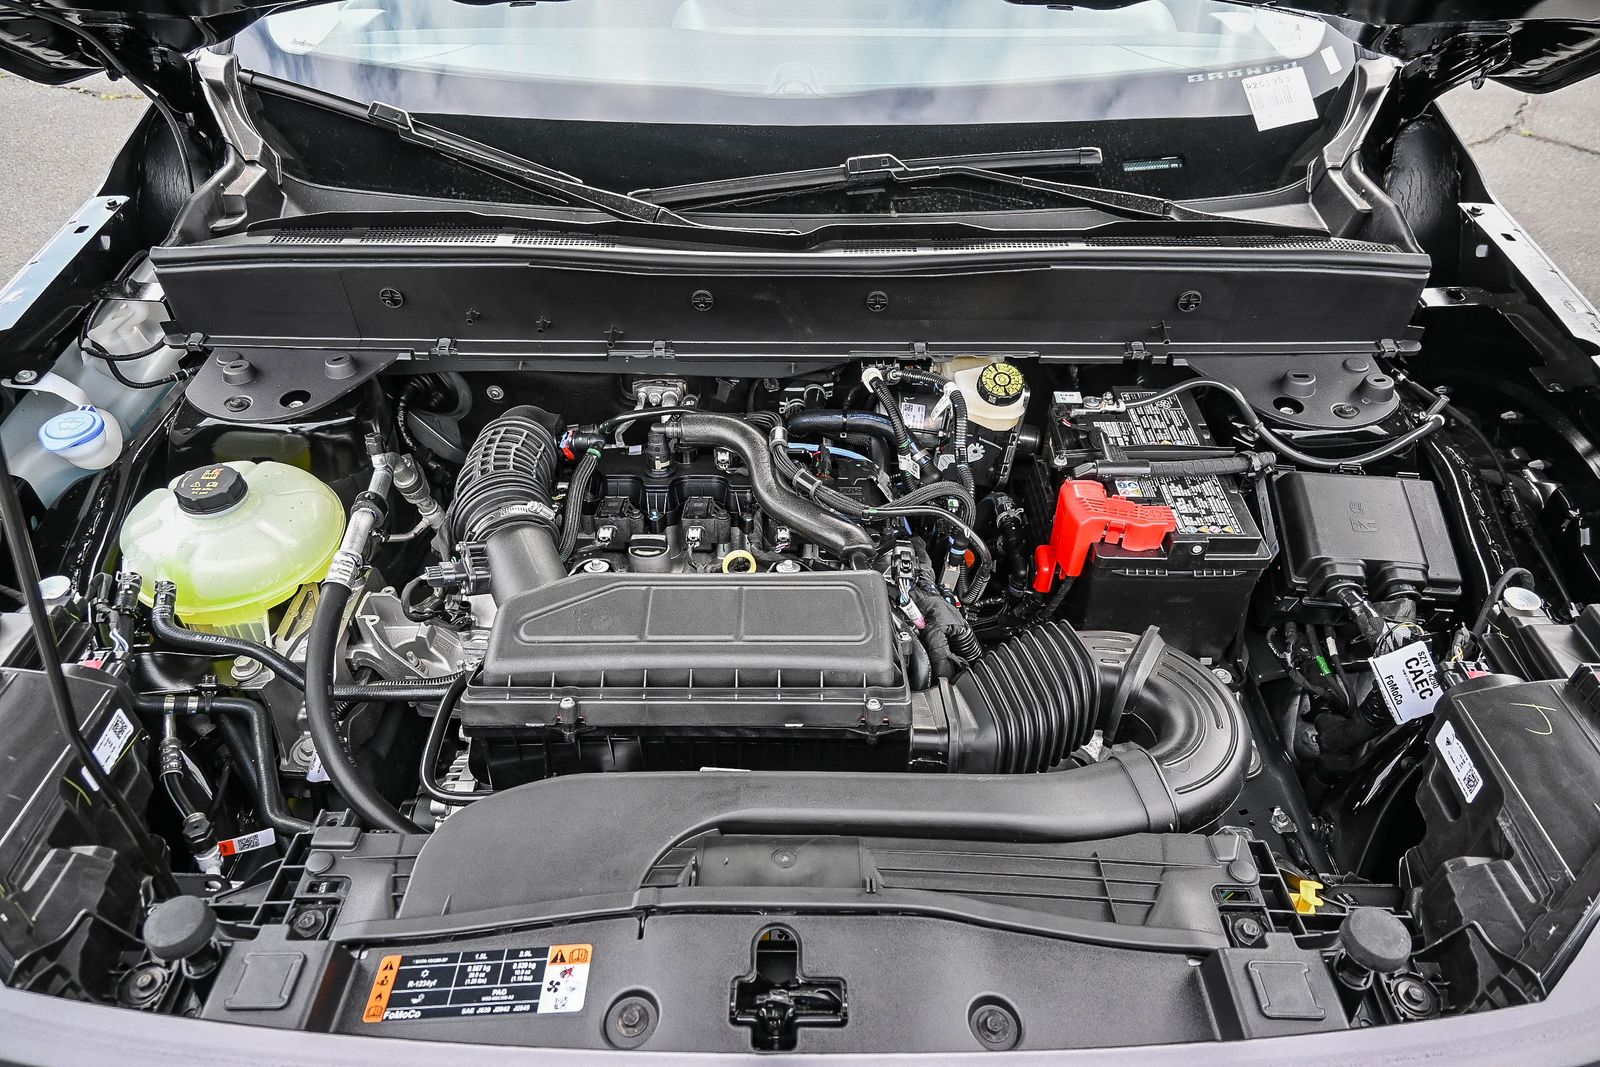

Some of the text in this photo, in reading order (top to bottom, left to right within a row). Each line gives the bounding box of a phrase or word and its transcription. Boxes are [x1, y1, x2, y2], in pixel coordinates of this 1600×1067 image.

[1384, 674, 1404, 706] FoMoCo
[1404, 657, 1434, 700] CAEC
[383, 1009, 422, 1020] FoMoCo
